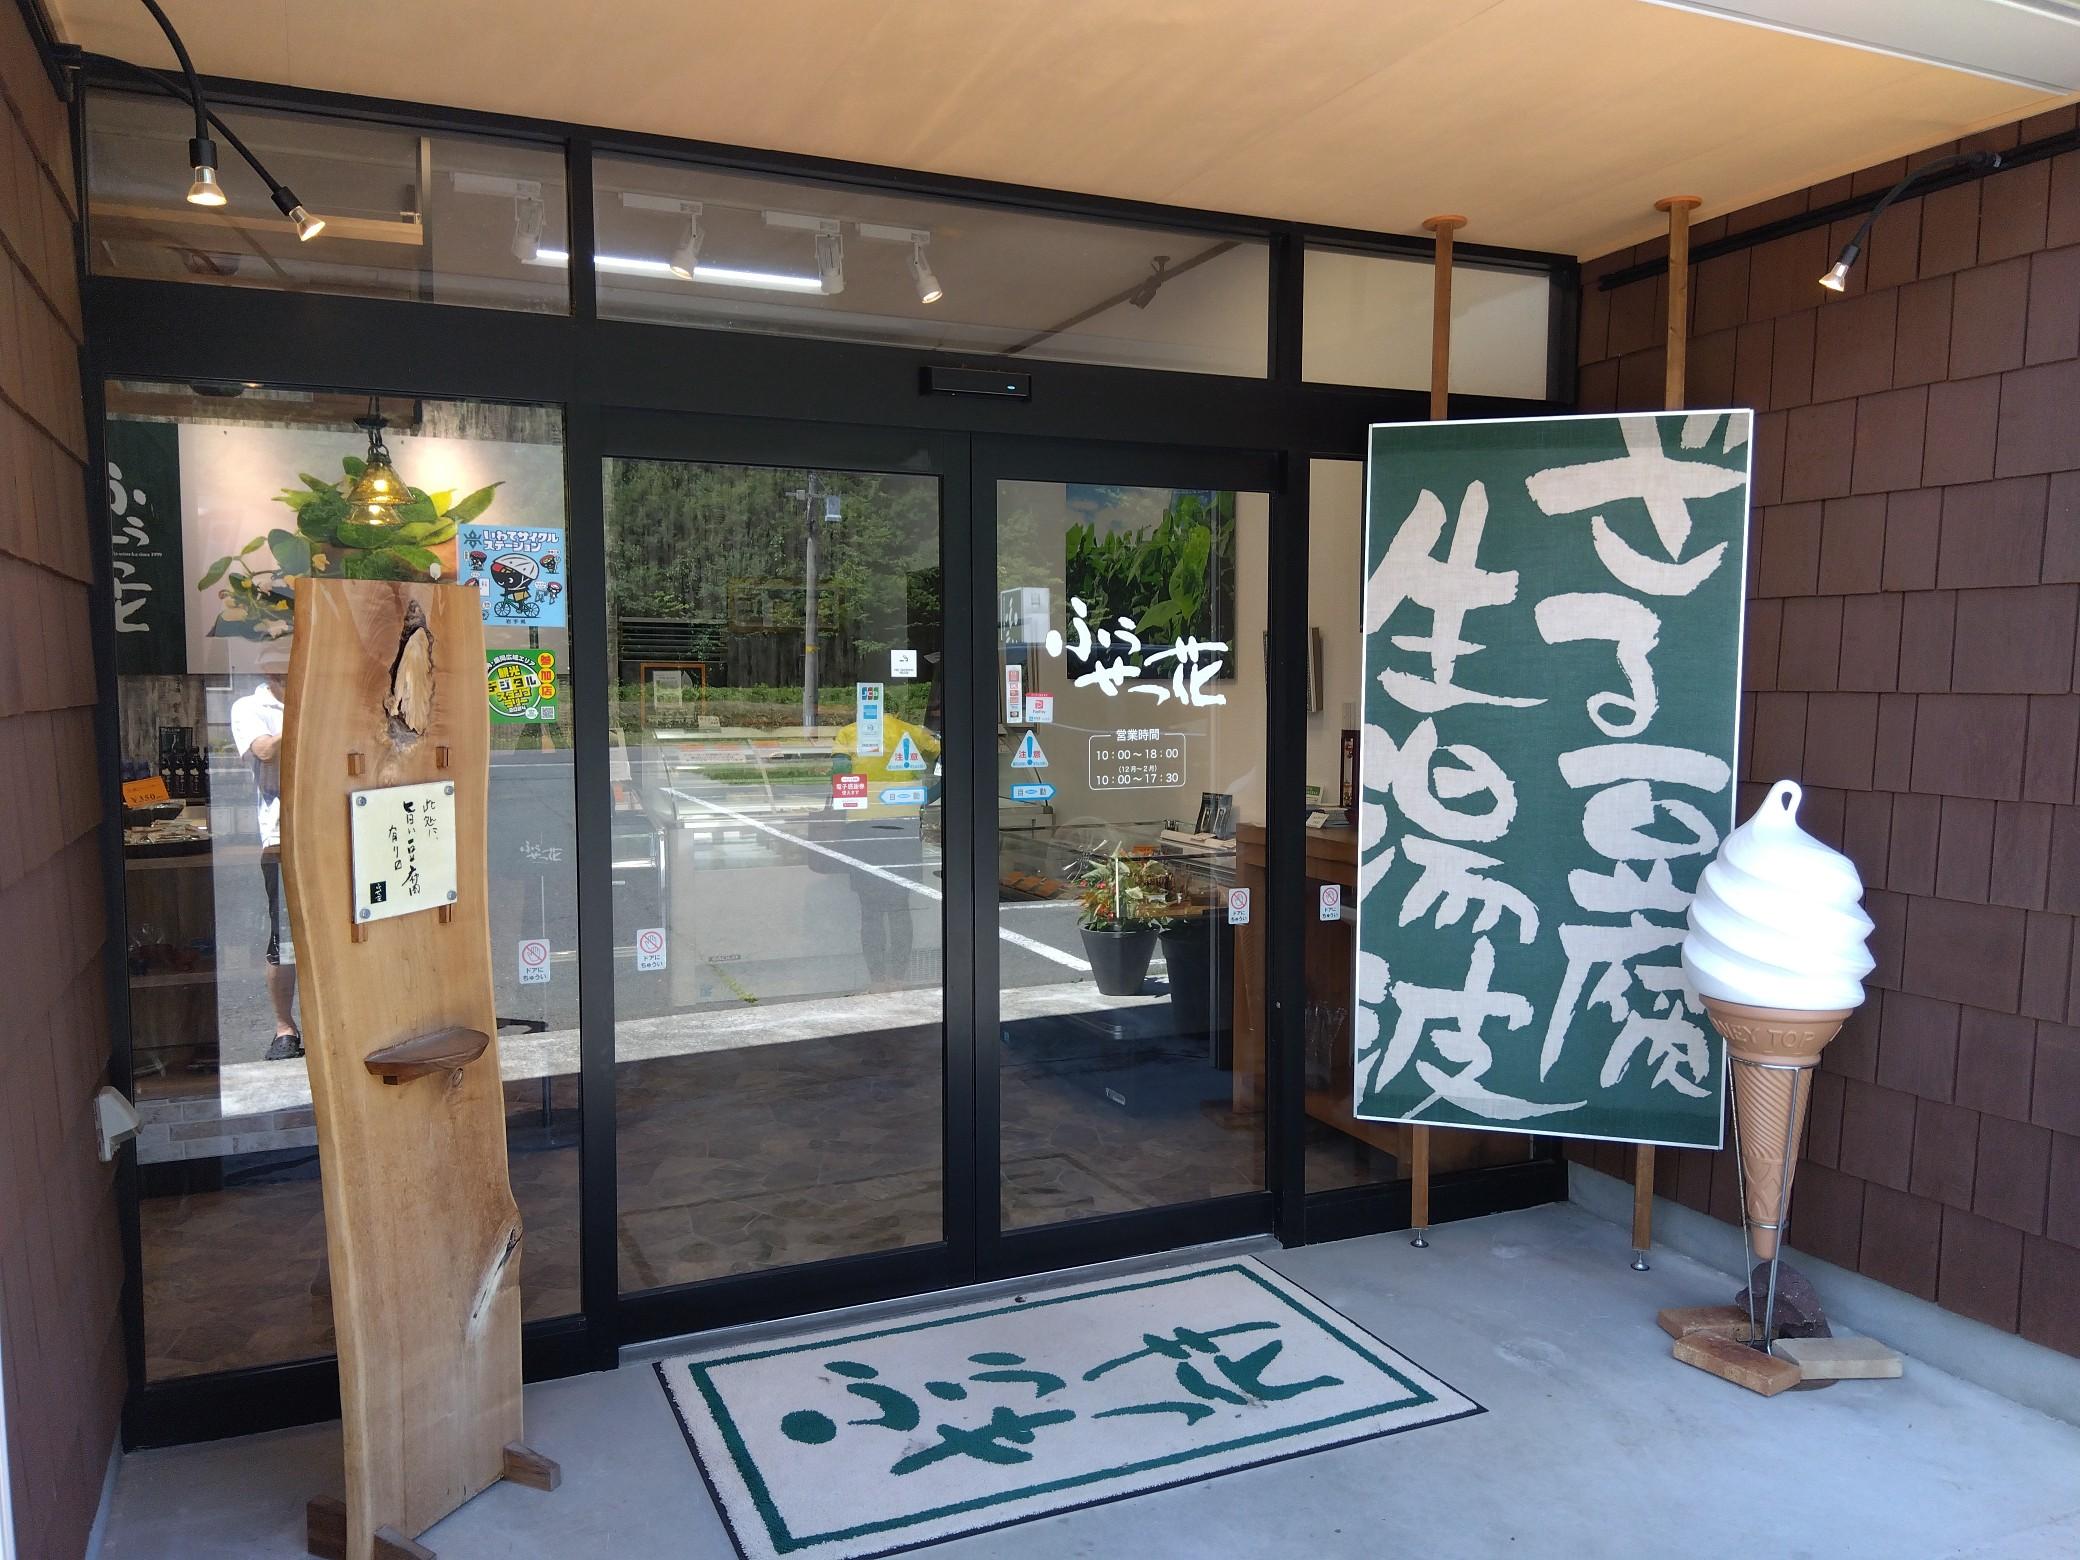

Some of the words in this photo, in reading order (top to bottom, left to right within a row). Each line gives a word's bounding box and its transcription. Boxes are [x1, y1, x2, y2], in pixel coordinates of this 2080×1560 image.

[482, 530, 559, 543] いわてサイクル
[483, 541, 542, 552] ステーション
[1045, 596, 1229, 707] ふうせつ花
[1116, 728, 1160, 742] 営業時間
[523, 973, 547, 981] ちゅうい
[1766, 1028, 1816, 1049] TOP
